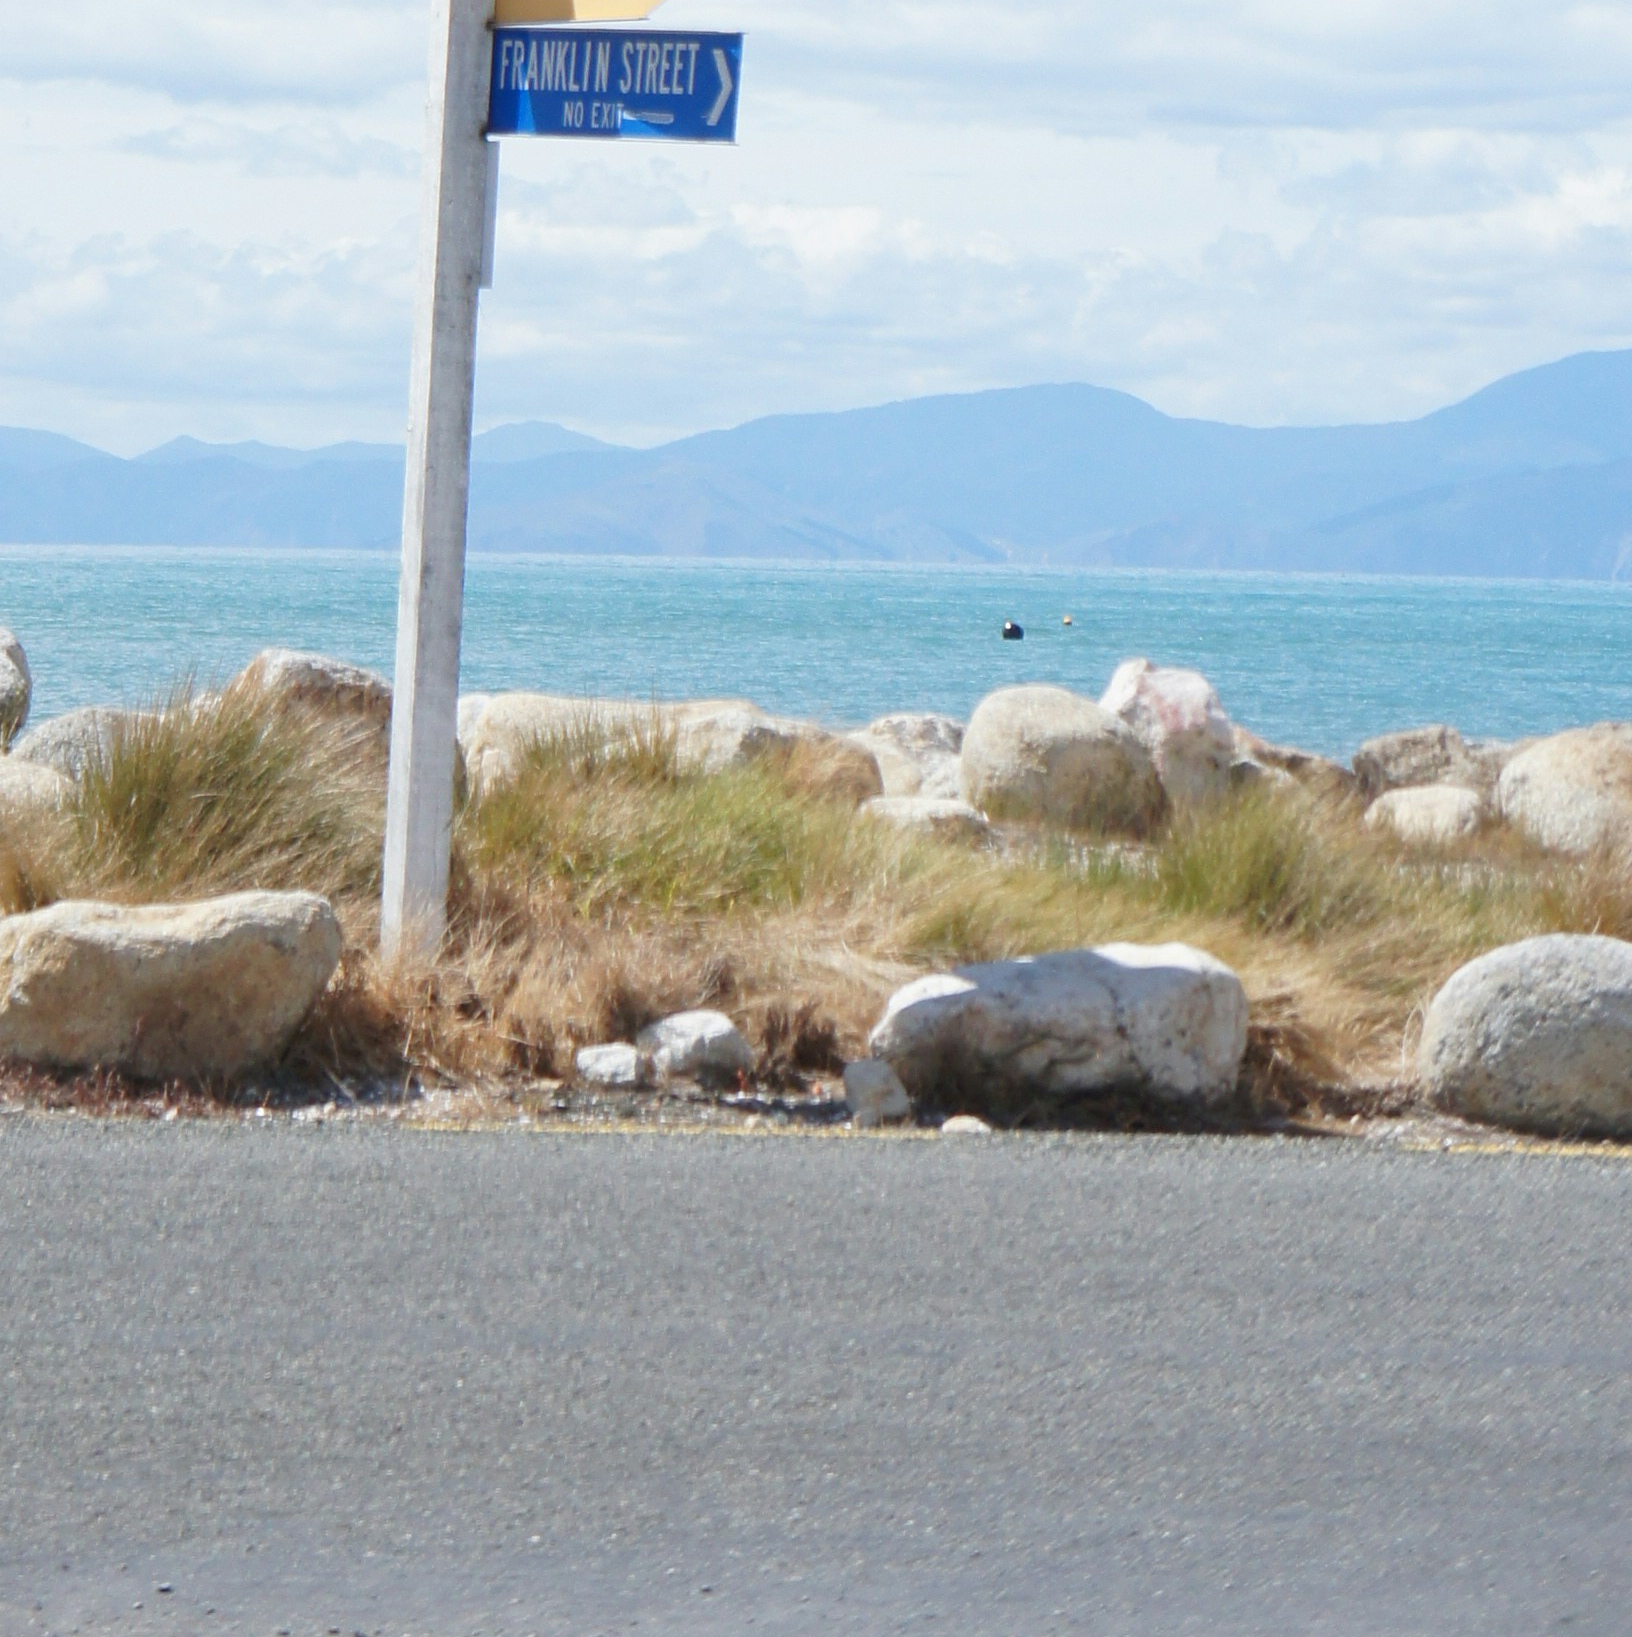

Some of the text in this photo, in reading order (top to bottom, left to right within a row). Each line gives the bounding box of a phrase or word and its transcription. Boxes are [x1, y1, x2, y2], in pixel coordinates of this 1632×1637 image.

[500, 39, 700, 95] FRANKLIN STREET
[563, 101, 624, 128] NO EXIT
